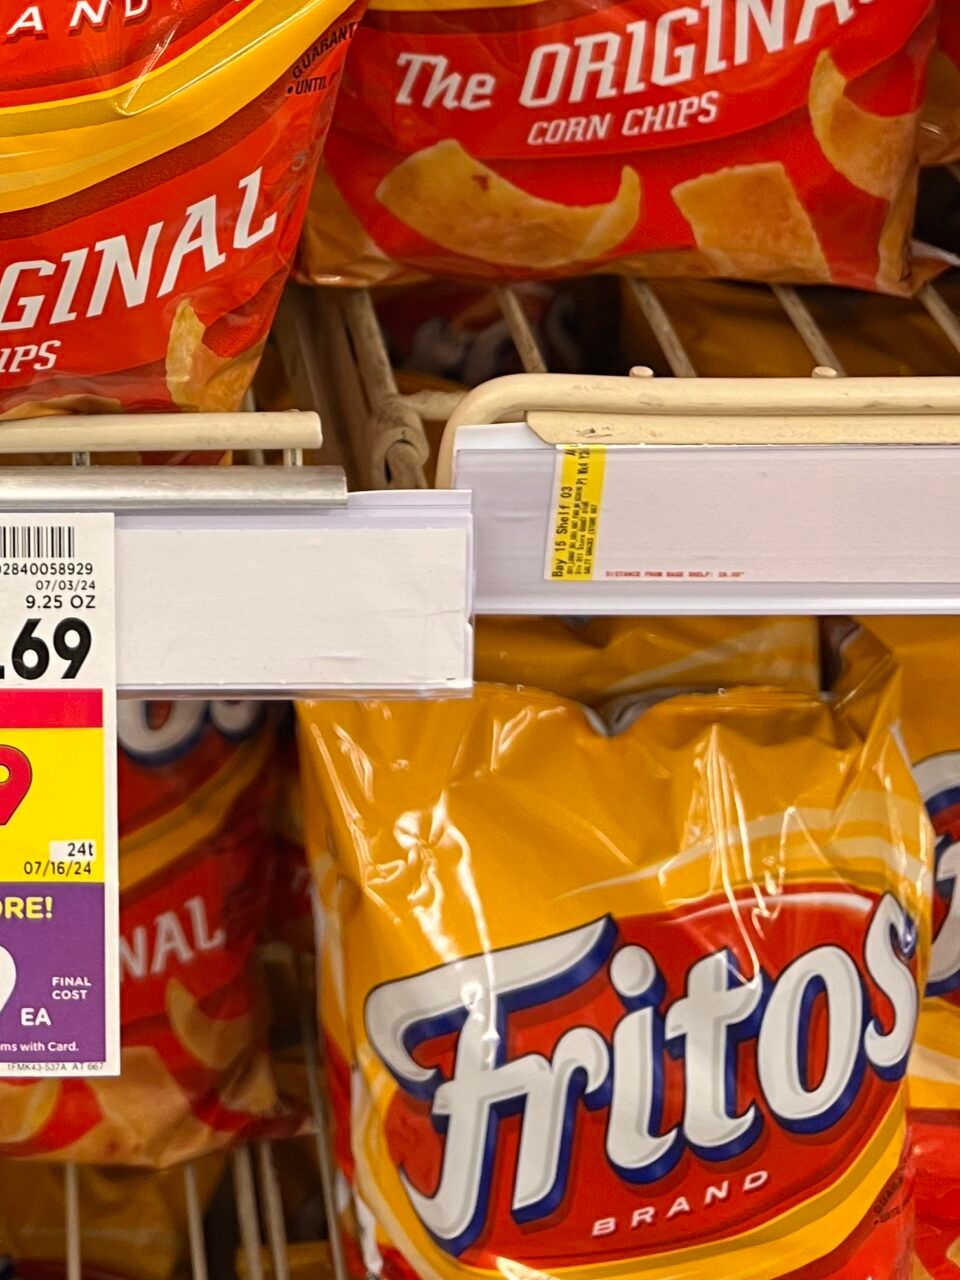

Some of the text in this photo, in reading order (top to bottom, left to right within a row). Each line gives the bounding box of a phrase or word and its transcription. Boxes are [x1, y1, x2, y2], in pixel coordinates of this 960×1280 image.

[292, 22, 356, 79] GUARANT
[296, 75, 327, 95] UNTIL
[396, 52, 495, 111] The
[527, 90, 720, 146] CORN CHIPS
[552, 486, 572, 577] Bay 15 Shelf 03
[35, 579, 96, 592] 07/03/24
[25, 594, 63, 609] 9.25
[70, 594, 96, 609] OZ
[67, 842, 94, 857] 24t
[23, 860, 92, 876] 07/16/24
[51, 976, 92, 988] FINAL
[51, 989, 87, 1001] COST
[20, 1007, 52, 1027] EA
[20, 1041, 45, 1052] with
[47, 1041, 79, 1052] Card.
[364, 894, 918, 1254] Fritos
[592, 1170, 771, 1237] BRAND
